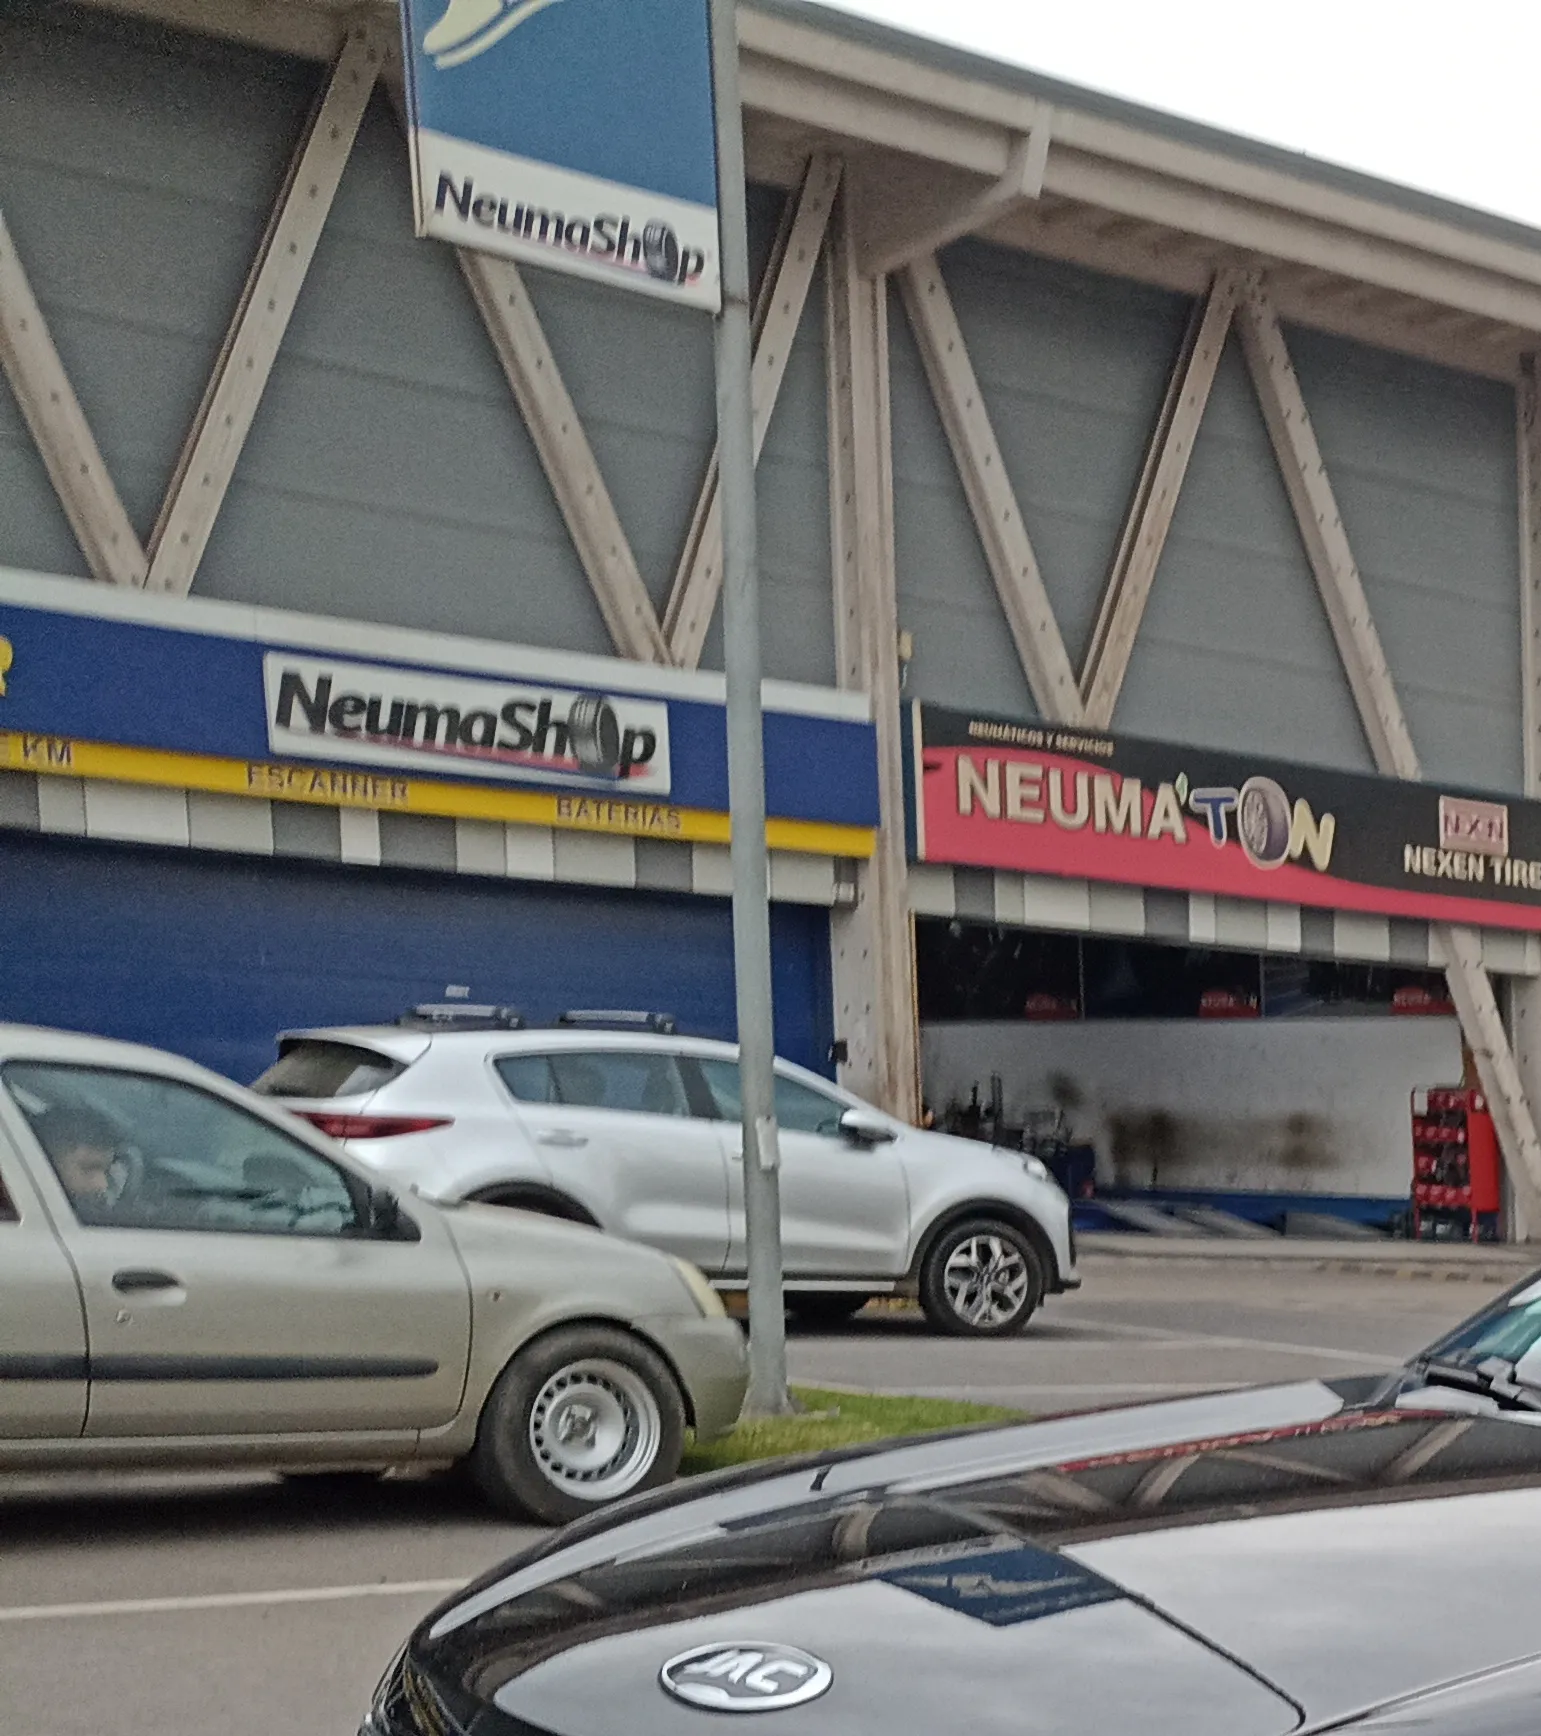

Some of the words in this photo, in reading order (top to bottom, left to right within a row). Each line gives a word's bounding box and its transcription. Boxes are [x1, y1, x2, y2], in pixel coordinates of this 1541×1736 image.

[435, 169, 705, 287] NeumaShop
[274, 668, 657, 780] NeumaShop
[1404, 843, 1485, 882] NEXEN
